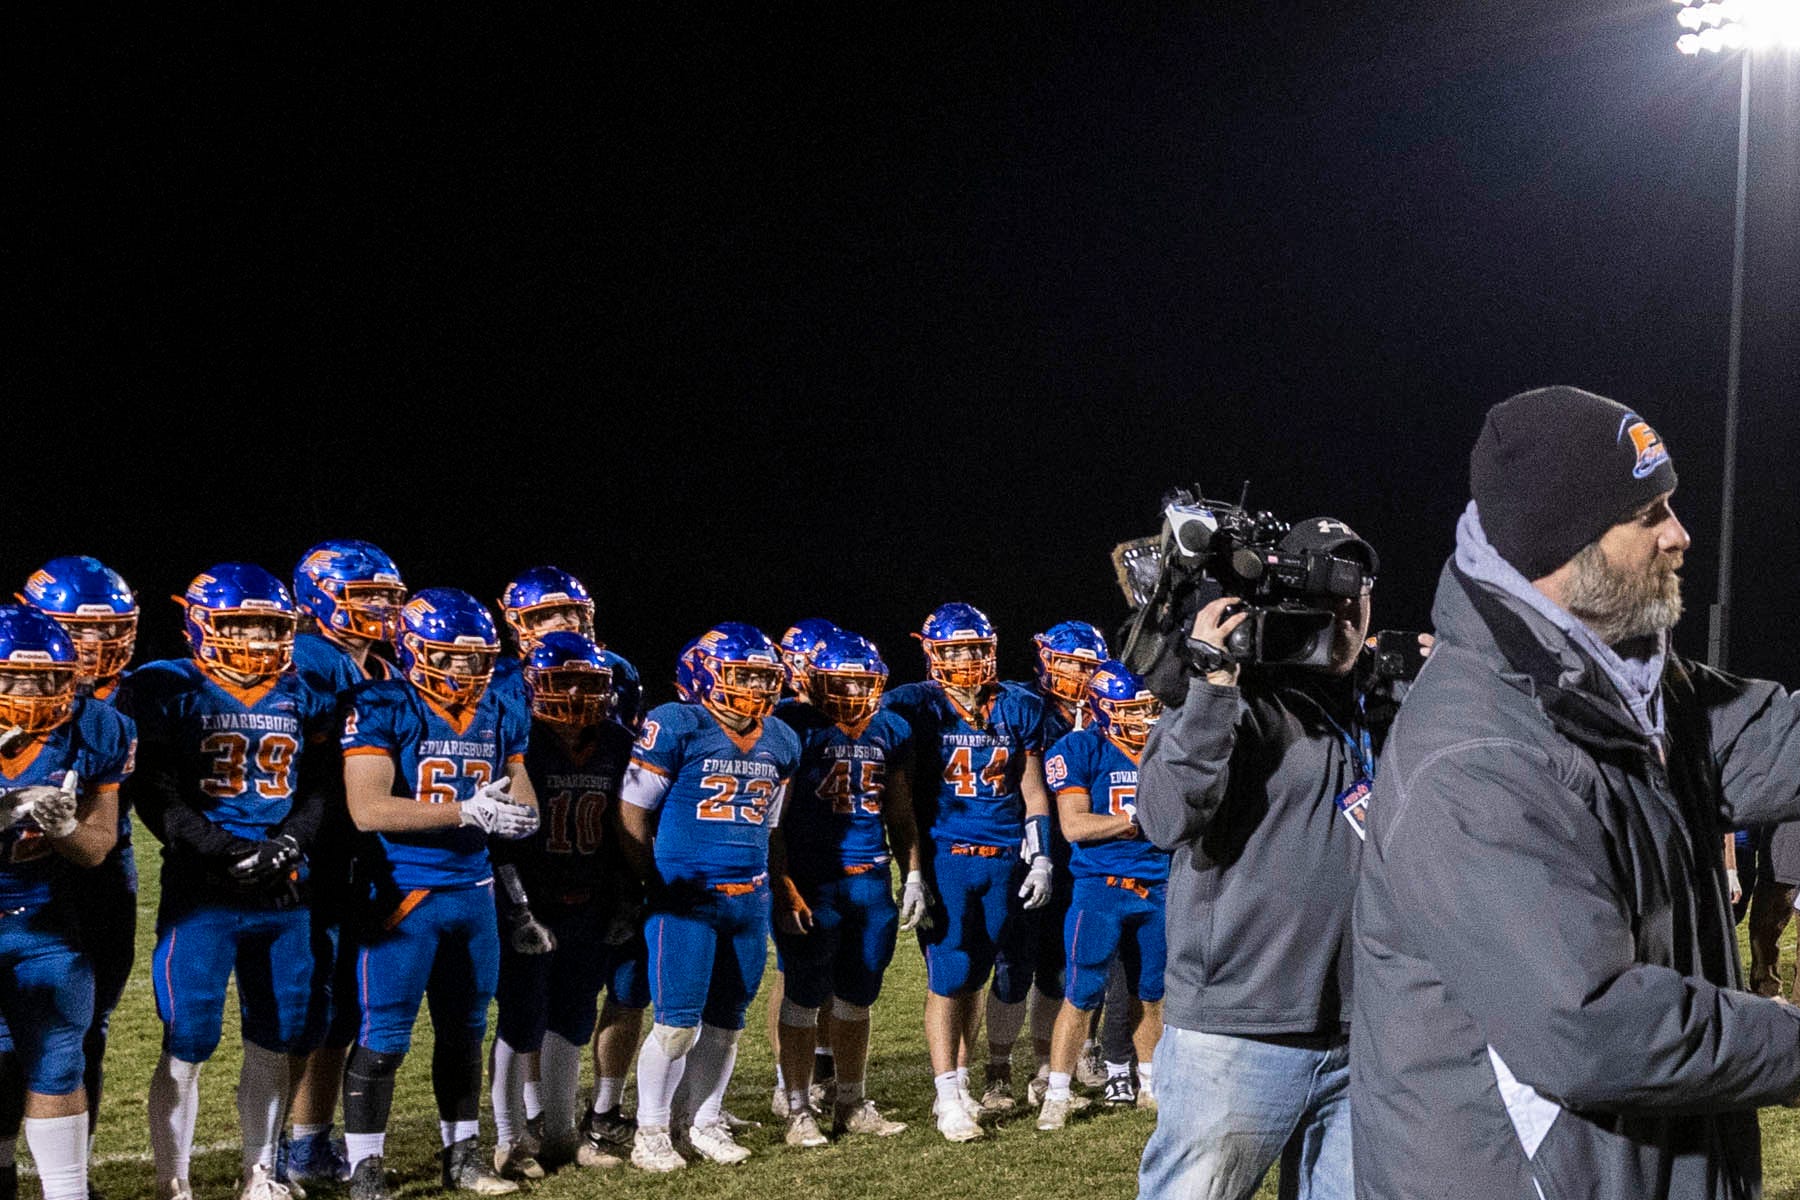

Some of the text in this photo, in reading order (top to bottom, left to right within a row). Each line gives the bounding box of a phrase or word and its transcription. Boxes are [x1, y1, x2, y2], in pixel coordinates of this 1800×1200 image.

[202, 713, 298, 732] EDWARDSBURG
[943, 734, 1010, 748] EDWARDSBURG
[200, 731, 299, 799] 39
[418, 739, 497, 758] EDWARDSBURG
[814, 760, 886, 815] 45
[943, 746, 1009, 798] 44
[1045, 754, 1068, 785] 59
[1109, 770, 1138, 784] EDWAR
[696, 772, 775, 826] 23
[546, 789, 608, 856] 10
